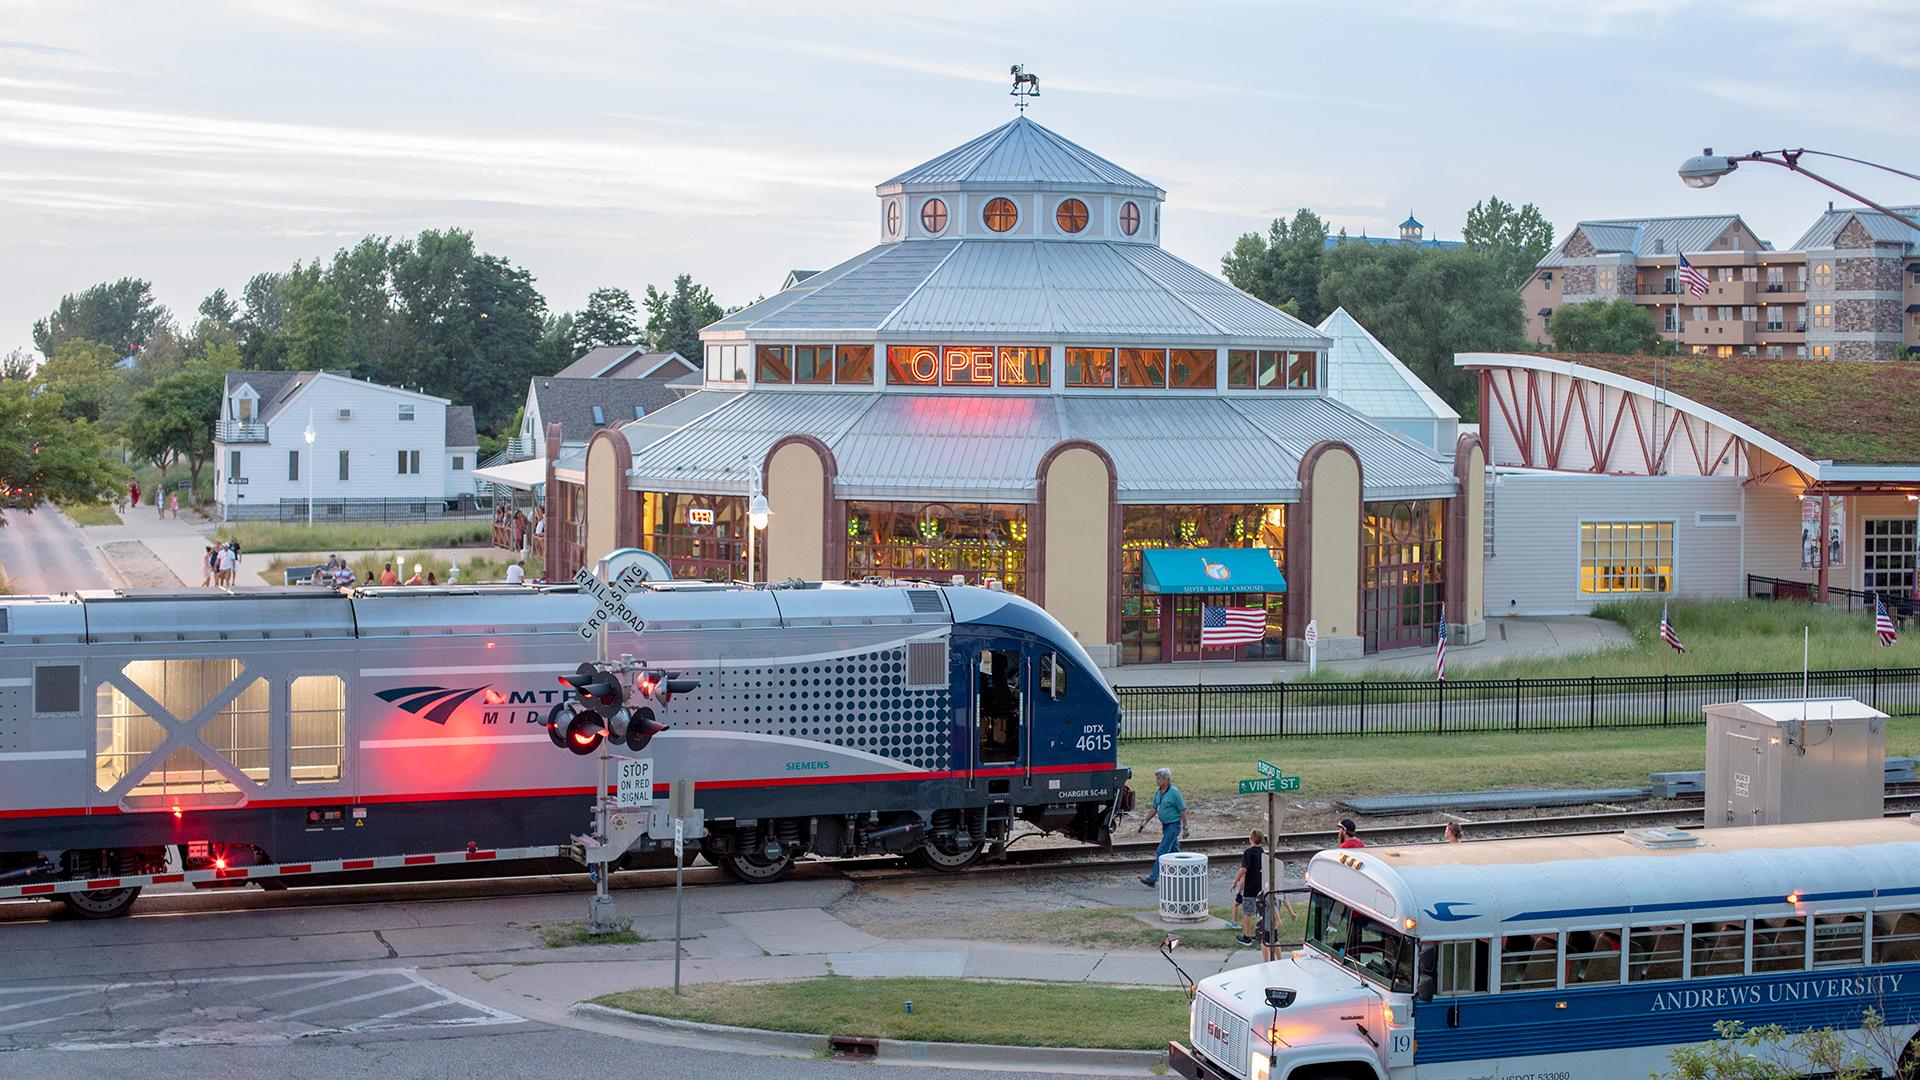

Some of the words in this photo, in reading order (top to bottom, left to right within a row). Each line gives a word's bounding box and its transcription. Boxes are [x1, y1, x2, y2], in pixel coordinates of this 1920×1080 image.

[911, 350, 1025, 383] OPEN
[691, 511, 712, 522] OPEN
[581, 566, 643, 639] CROSSING
[1083, 724, 1104, 734] IDTX
[1075, 734, 1112, 751] 4615
[623, 763, 649, 778] STOP
[785, 760, 830, 771] SIEMENS
[621, 780, 632, 790] ON
[635, 779, 650, 789] RED
[1249, 779, 1276, 791] VINE
[1280, 778, 1298, 790] ST.
[621, 792, 649, 803] SIGNAL
[1058, 790, 1089, 798] CHARGER
[1090, 789, 1108, 797] SC-44
[1650, 984, 1761, 1012] ANDREWS
[1768, 974, 1903, 1003] UNIVERSITY
[1393, 1035, 1410, 1053] 19
